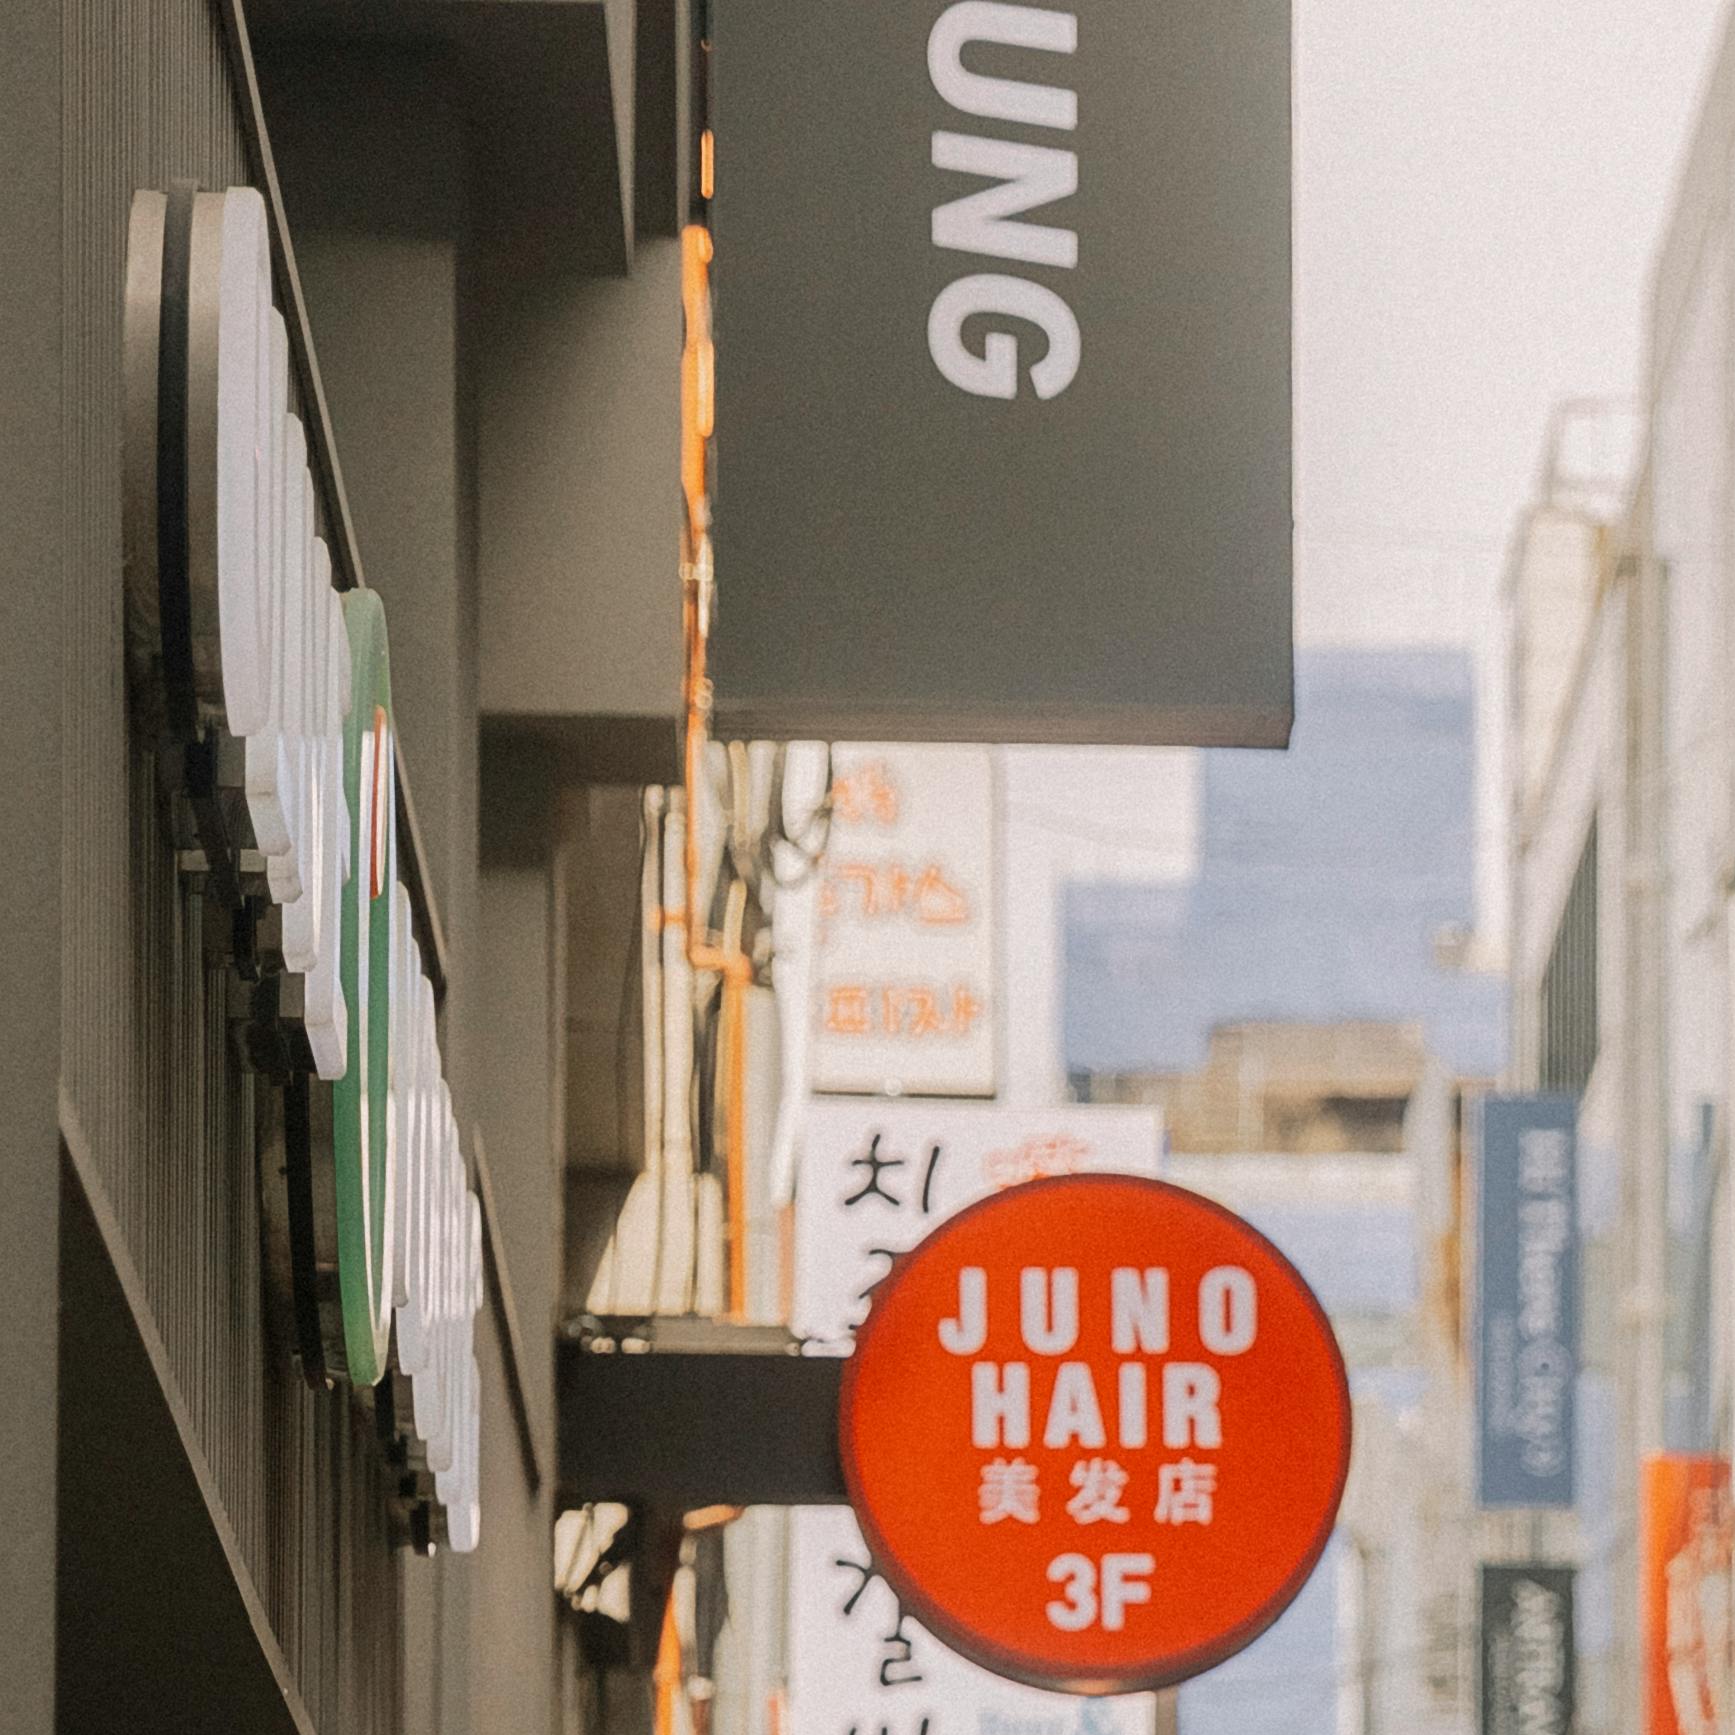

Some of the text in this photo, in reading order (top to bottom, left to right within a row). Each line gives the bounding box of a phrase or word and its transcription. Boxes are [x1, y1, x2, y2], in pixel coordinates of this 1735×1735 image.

[926, 0, 1082, 402] UNG
[937, 1265, 1259, 1357] JUNO
[970, 1361, 1223, 1451] HAIR
[978, 1458, 1218, 1526] 美发店
[1045, 1551, 1157, 1633] 3F
